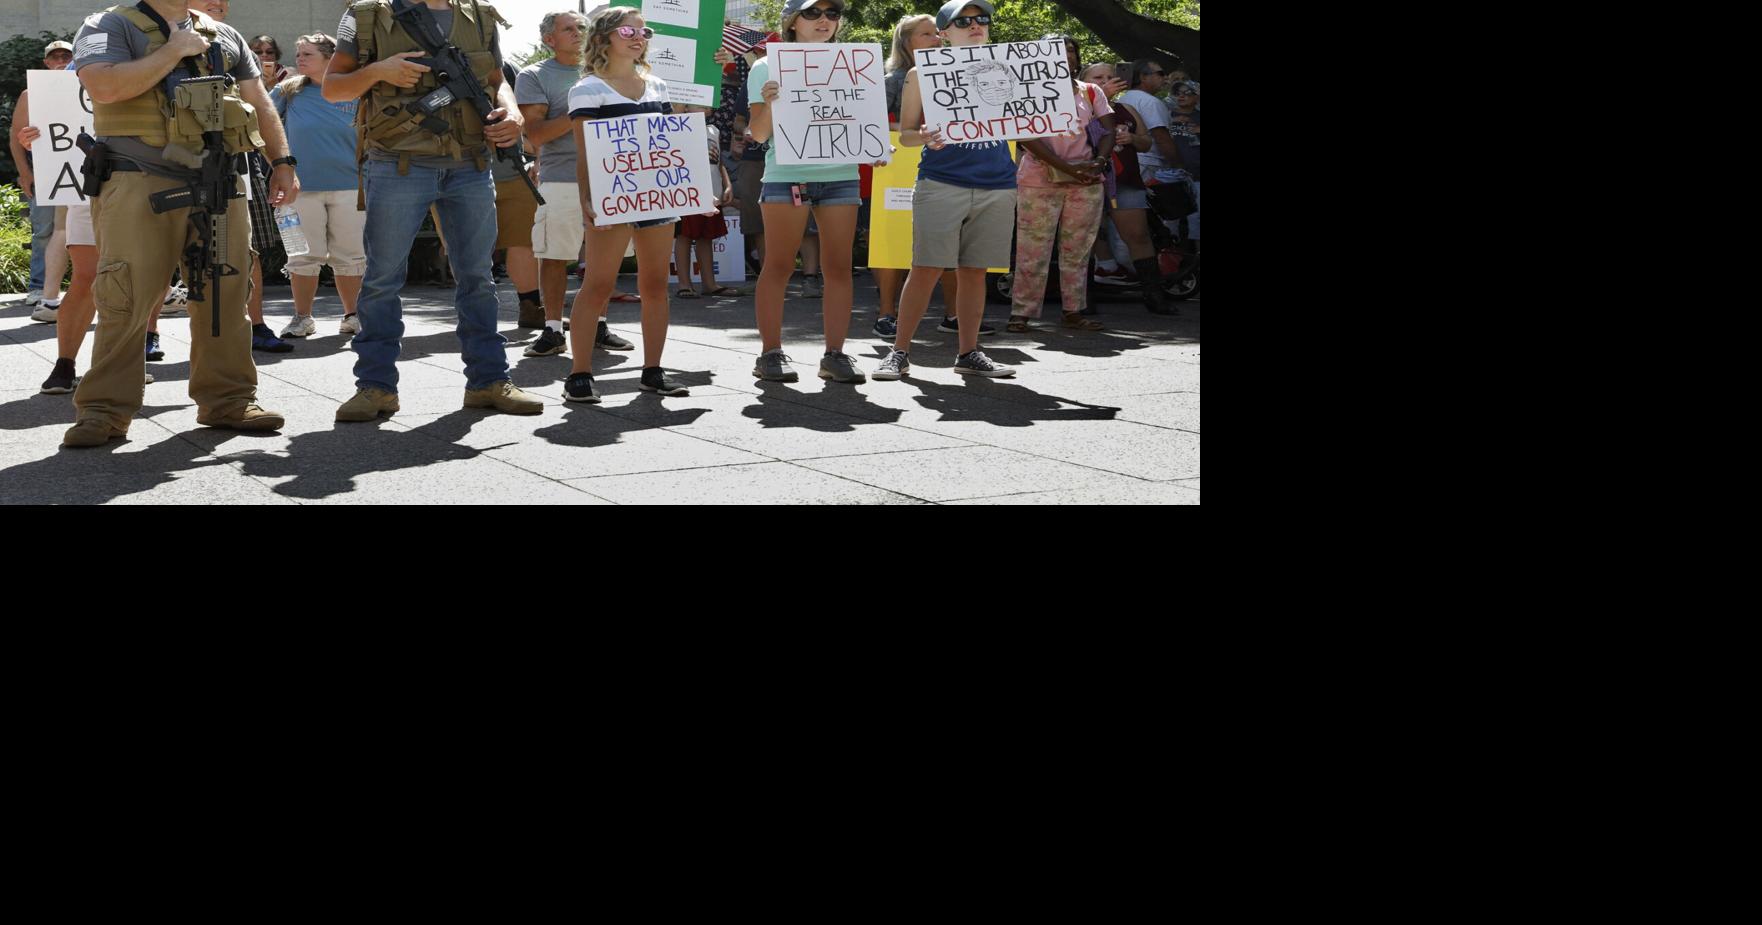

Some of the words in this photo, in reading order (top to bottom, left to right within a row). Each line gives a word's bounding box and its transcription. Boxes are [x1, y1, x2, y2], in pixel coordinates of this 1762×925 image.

[918, 48, 954, 67] IS
[961, 44, 999, 64] IT
[1006, 39, 1063, 63] ABOUT
[777, 49, 876, 87] FEAR
[924, 69, 969, 90] THE
[1009, 60, 1069, 83] VIRUS
[790, 90, 822, 103] IS
[829, 88, 866, 101] THE
[933, 86, 970, 107] OR
[1018, 81, 1060, 100] IS
[810, 105, 853, 119] REAL
[946, 105, 979, 123] IT
[1002, 96, 1059, 117] ABOUT
[587, 118, 638, 139] THAT
[647, 116, 692, 134] MASK
[946, 112, 1073, 141] CONTROL?
[611, 138, 640, 154] IS
[648, 133, 671, 151] AS
[778, 123, 884, 159] VIRUS
[602, 149, 685, 174] USELESS
[611, 172, 638, 194] AS
[656, 166, 691, 188] OUR
[601, 187, 701, 217] GOVERNOR
